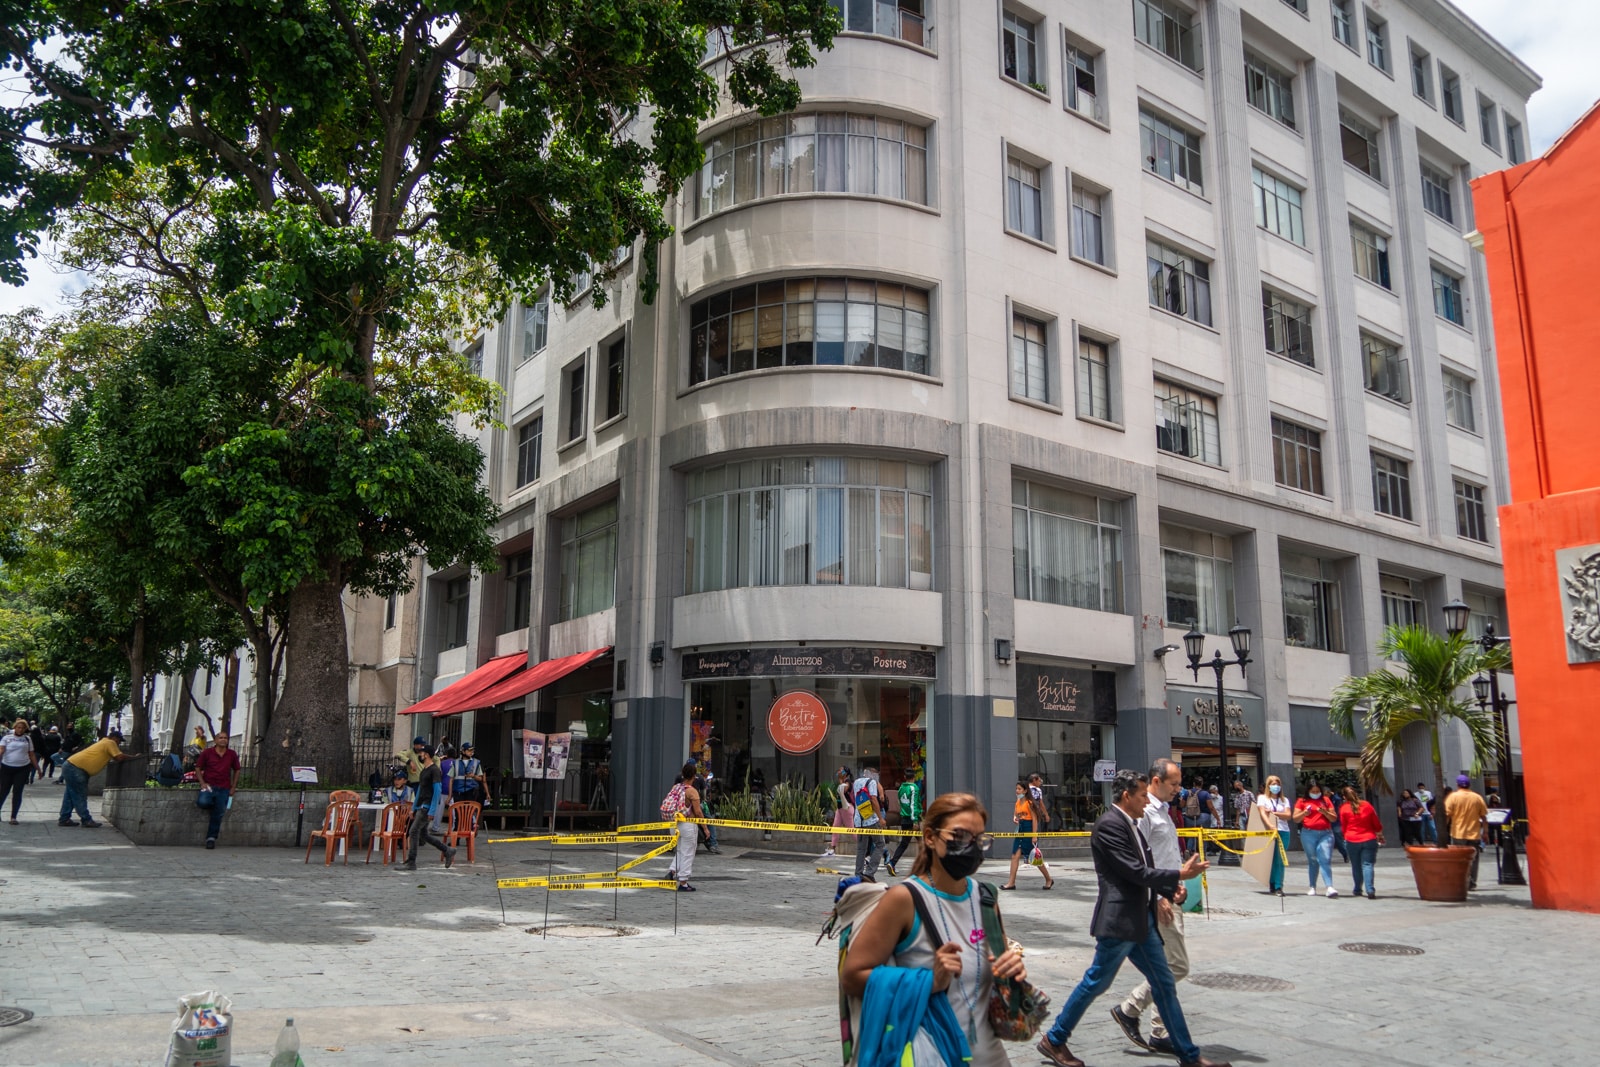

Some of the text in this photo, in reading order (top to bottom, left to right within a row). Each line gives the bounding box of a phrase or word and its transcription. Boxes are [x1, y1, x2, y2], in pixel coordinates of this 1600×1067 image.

[772, 655, 822, 666] Almuerzos
[873, 656, 907, 669] Postres
[1037, 675, 1080, 704] Bistró
[1042, 702, 1076, 712] Libertador
[779, 707, 820, 727] Bistró
